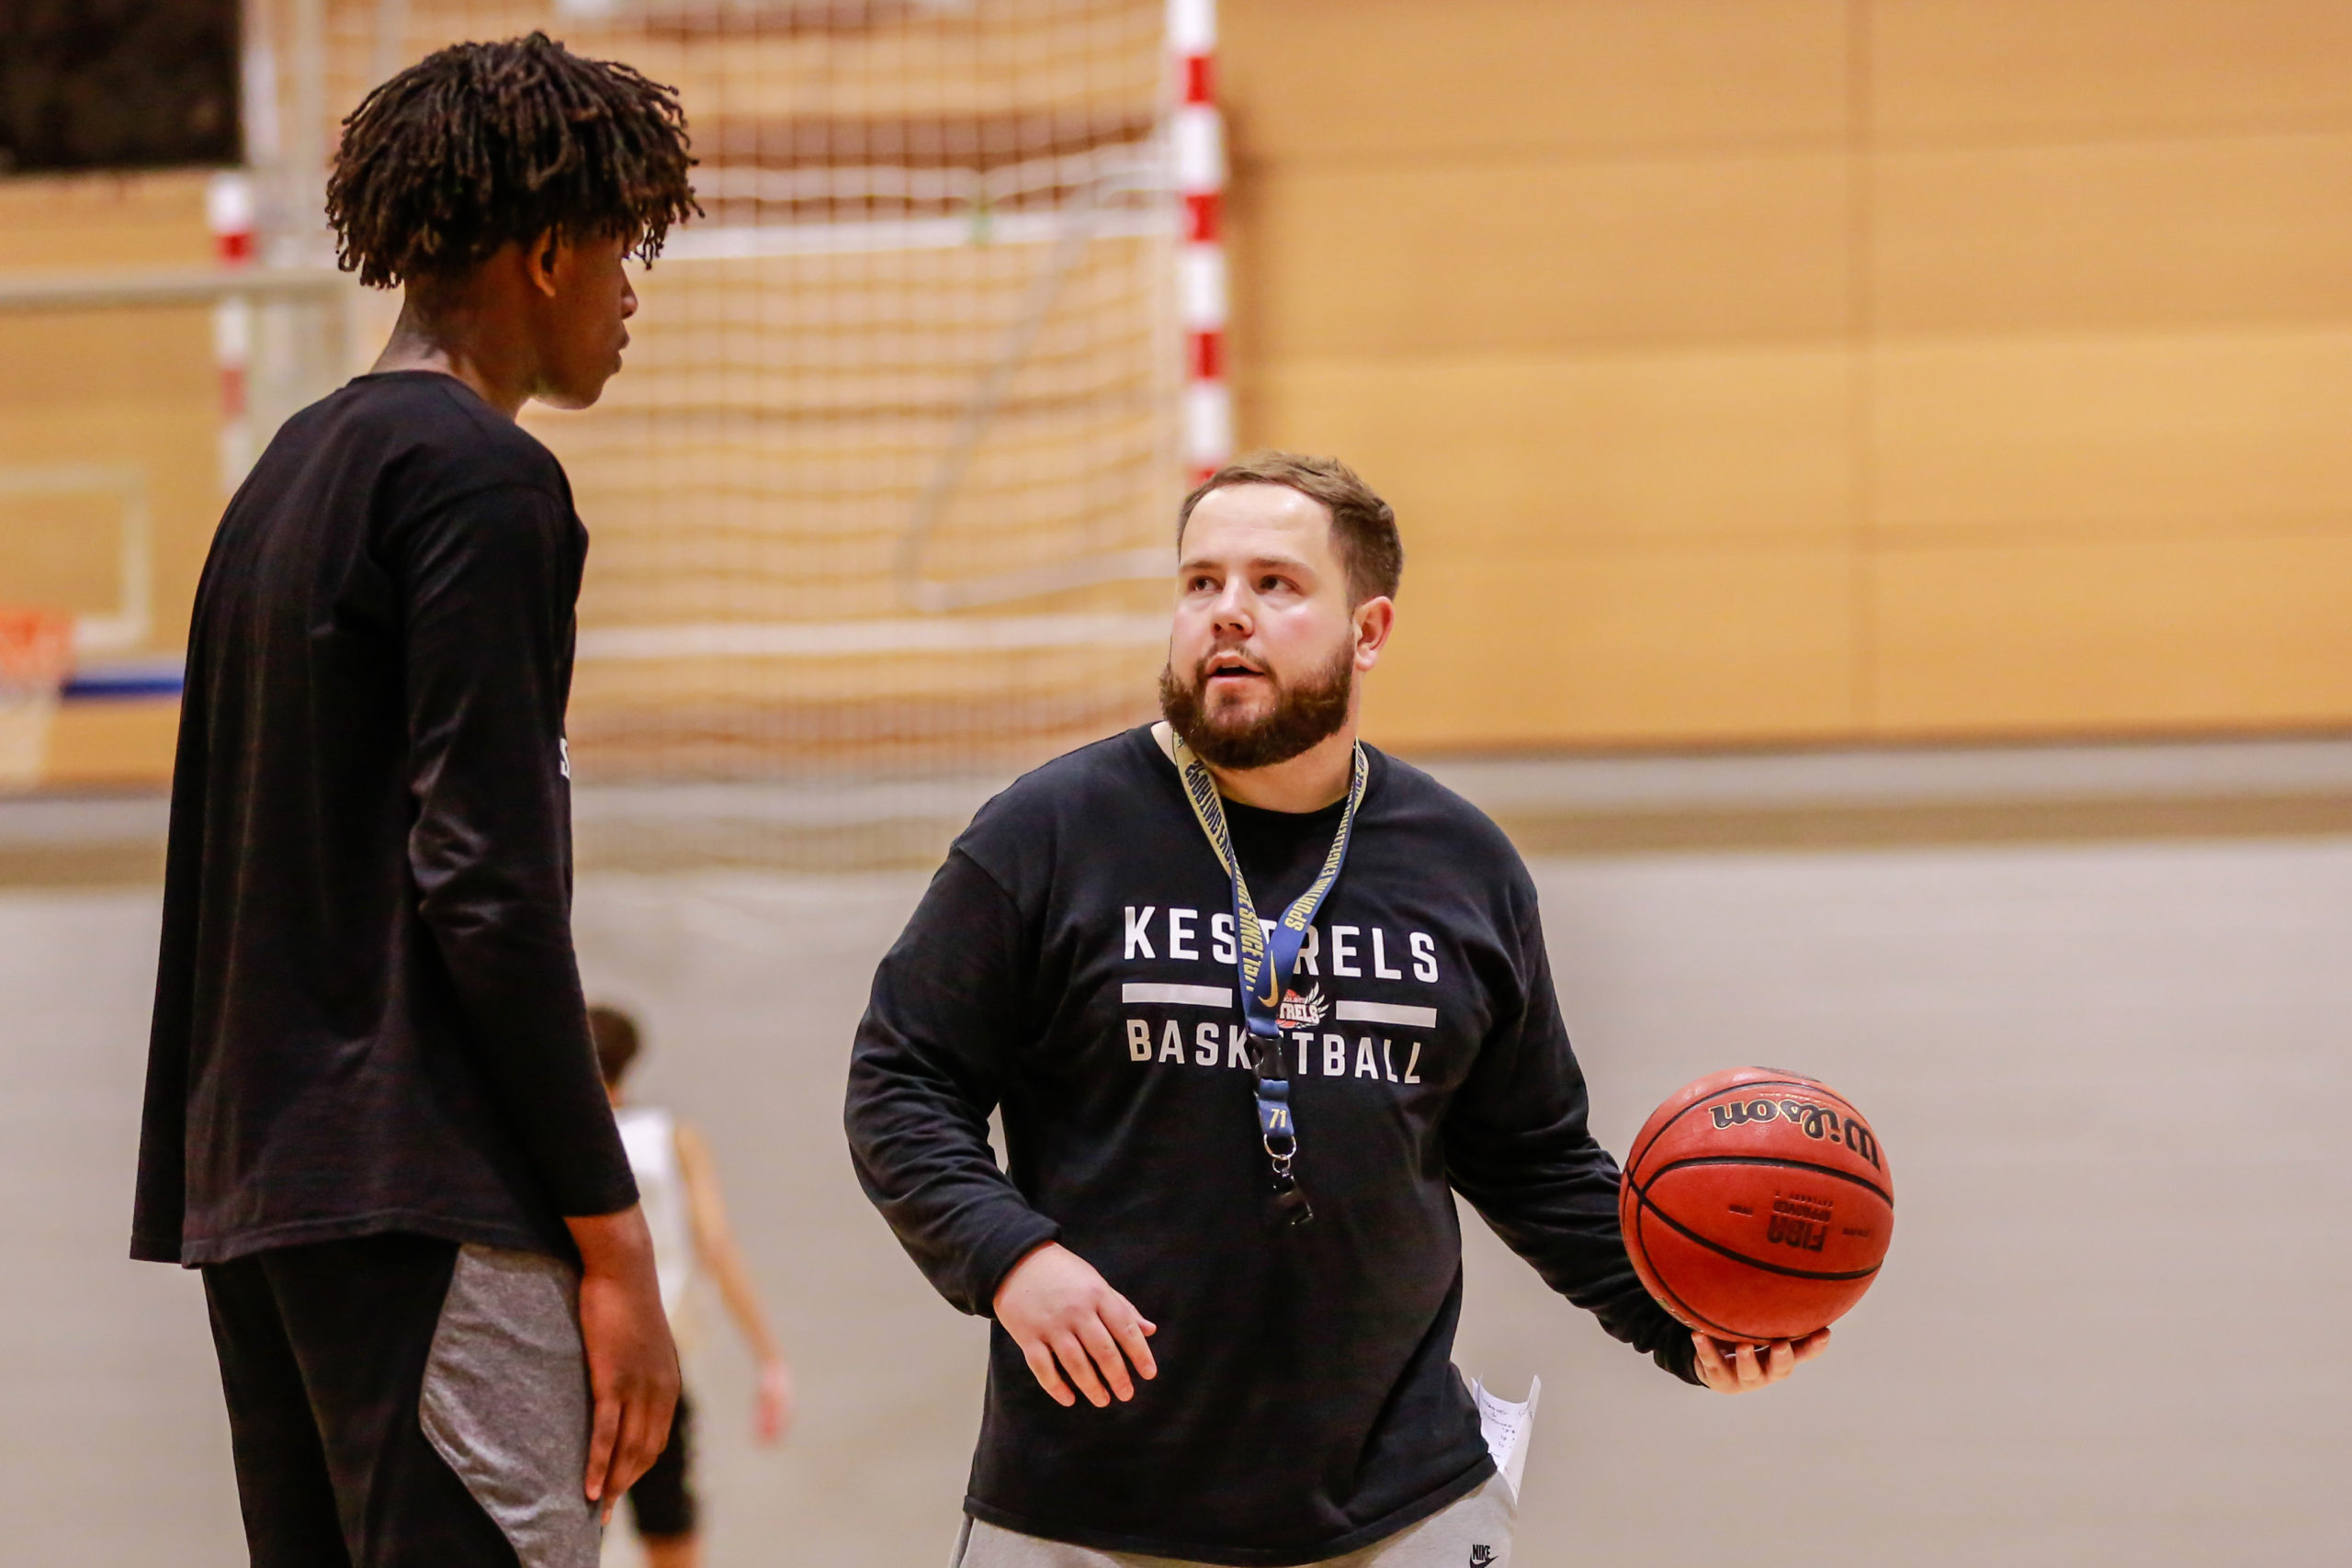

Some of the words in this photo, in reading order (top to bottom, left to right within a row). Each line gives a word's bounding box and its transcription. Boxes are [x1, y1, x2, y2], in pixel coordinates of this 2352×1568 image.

[1284, 876, 1332, 932] SPORTING
[1238, 906, 1265, 959] SINCE
[1125, 1019, 1422, 1085] BASKTBALL
[1269, 1108, 1287, 1129] 71
[1709, 1100, 1881, 1172] Wilson
[1767, 1214, 1828, 1253] FIBA
[1472, 1544, 1491, 1561] NIKE
